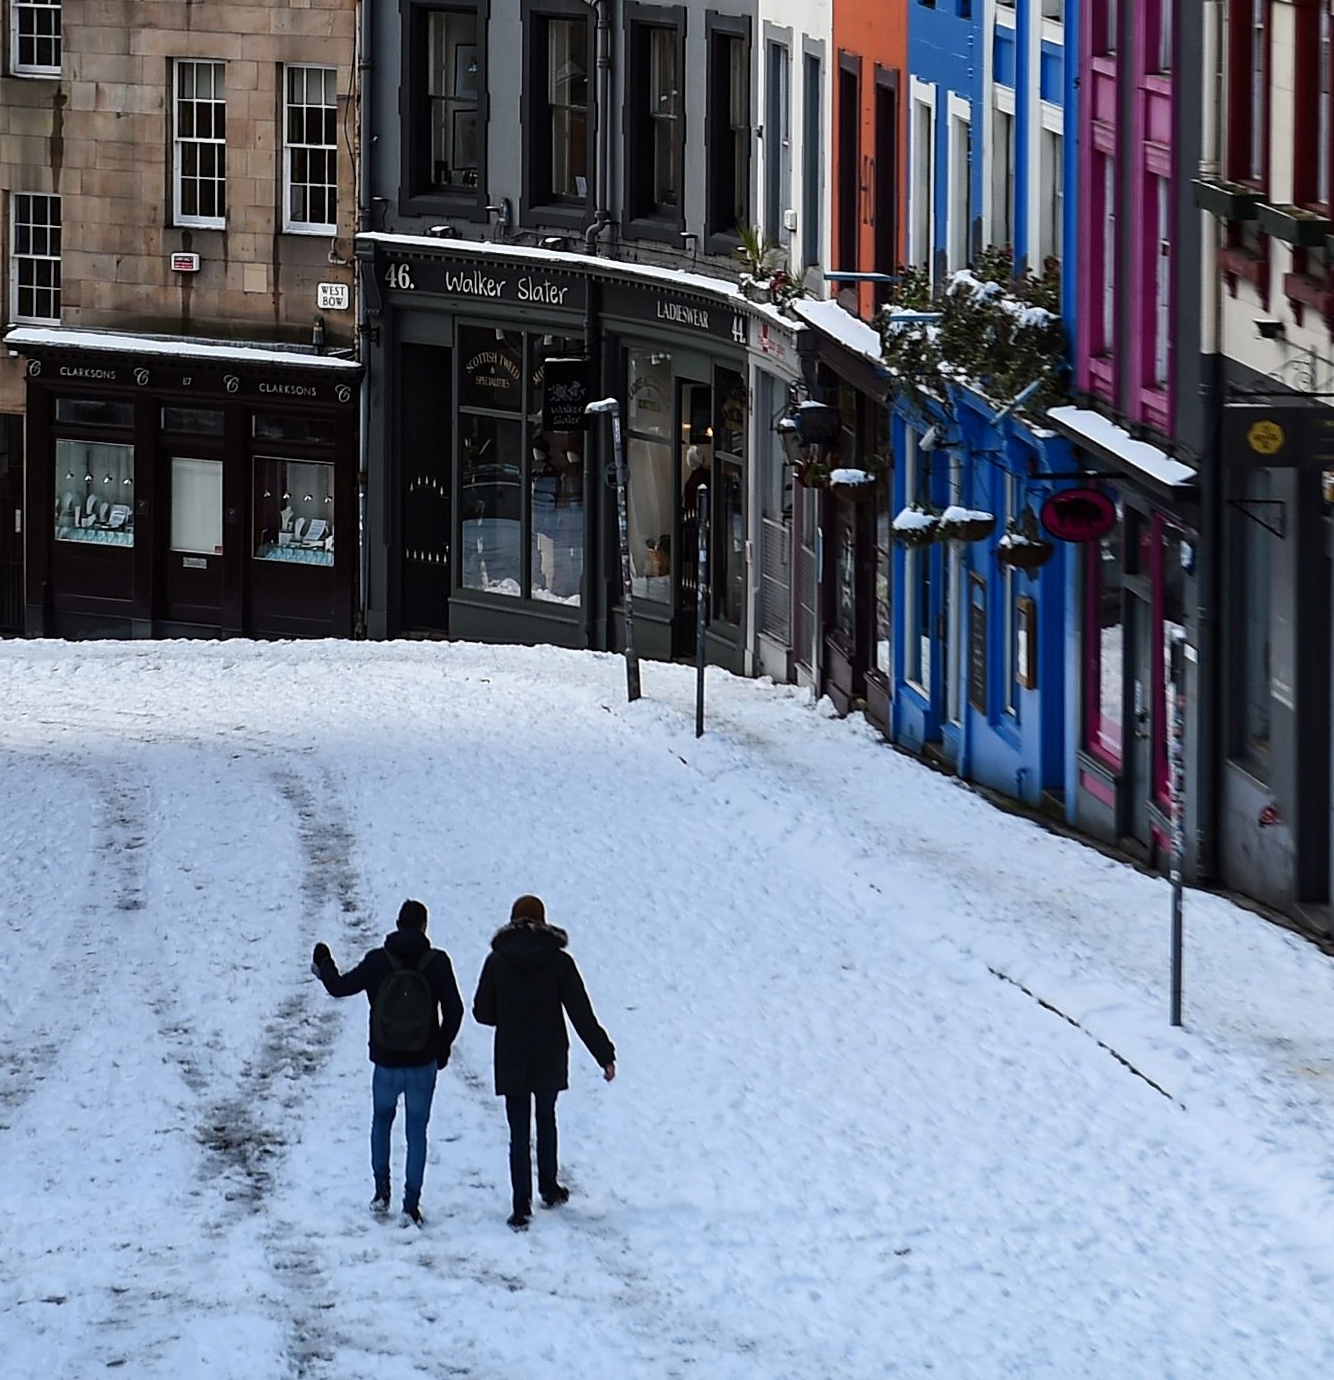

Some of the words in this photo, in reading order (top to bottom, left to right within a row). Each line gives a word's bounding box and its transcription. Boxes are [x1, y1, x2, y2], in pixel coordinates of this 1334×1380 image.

[321, 286, 345, 296] WEST
[384, 263, 415, 290] 46.
[444, 270, 507, 298] Walker
[517, 276, 568, 305] Slater
[322, 296, 343, 306] BOW
[657, 300, 709, 329] LADIESWEAR
[466, 351, 498, 375] SCOTTISH
[499, 353, 521, 380] TWEED
[59, 366, 117, 380] CLARKSONS
[259, 383, 318, 397] CLARKSONS
[550, 405, 584, 414] Walker
[553, 414, 582, 425] Slater
